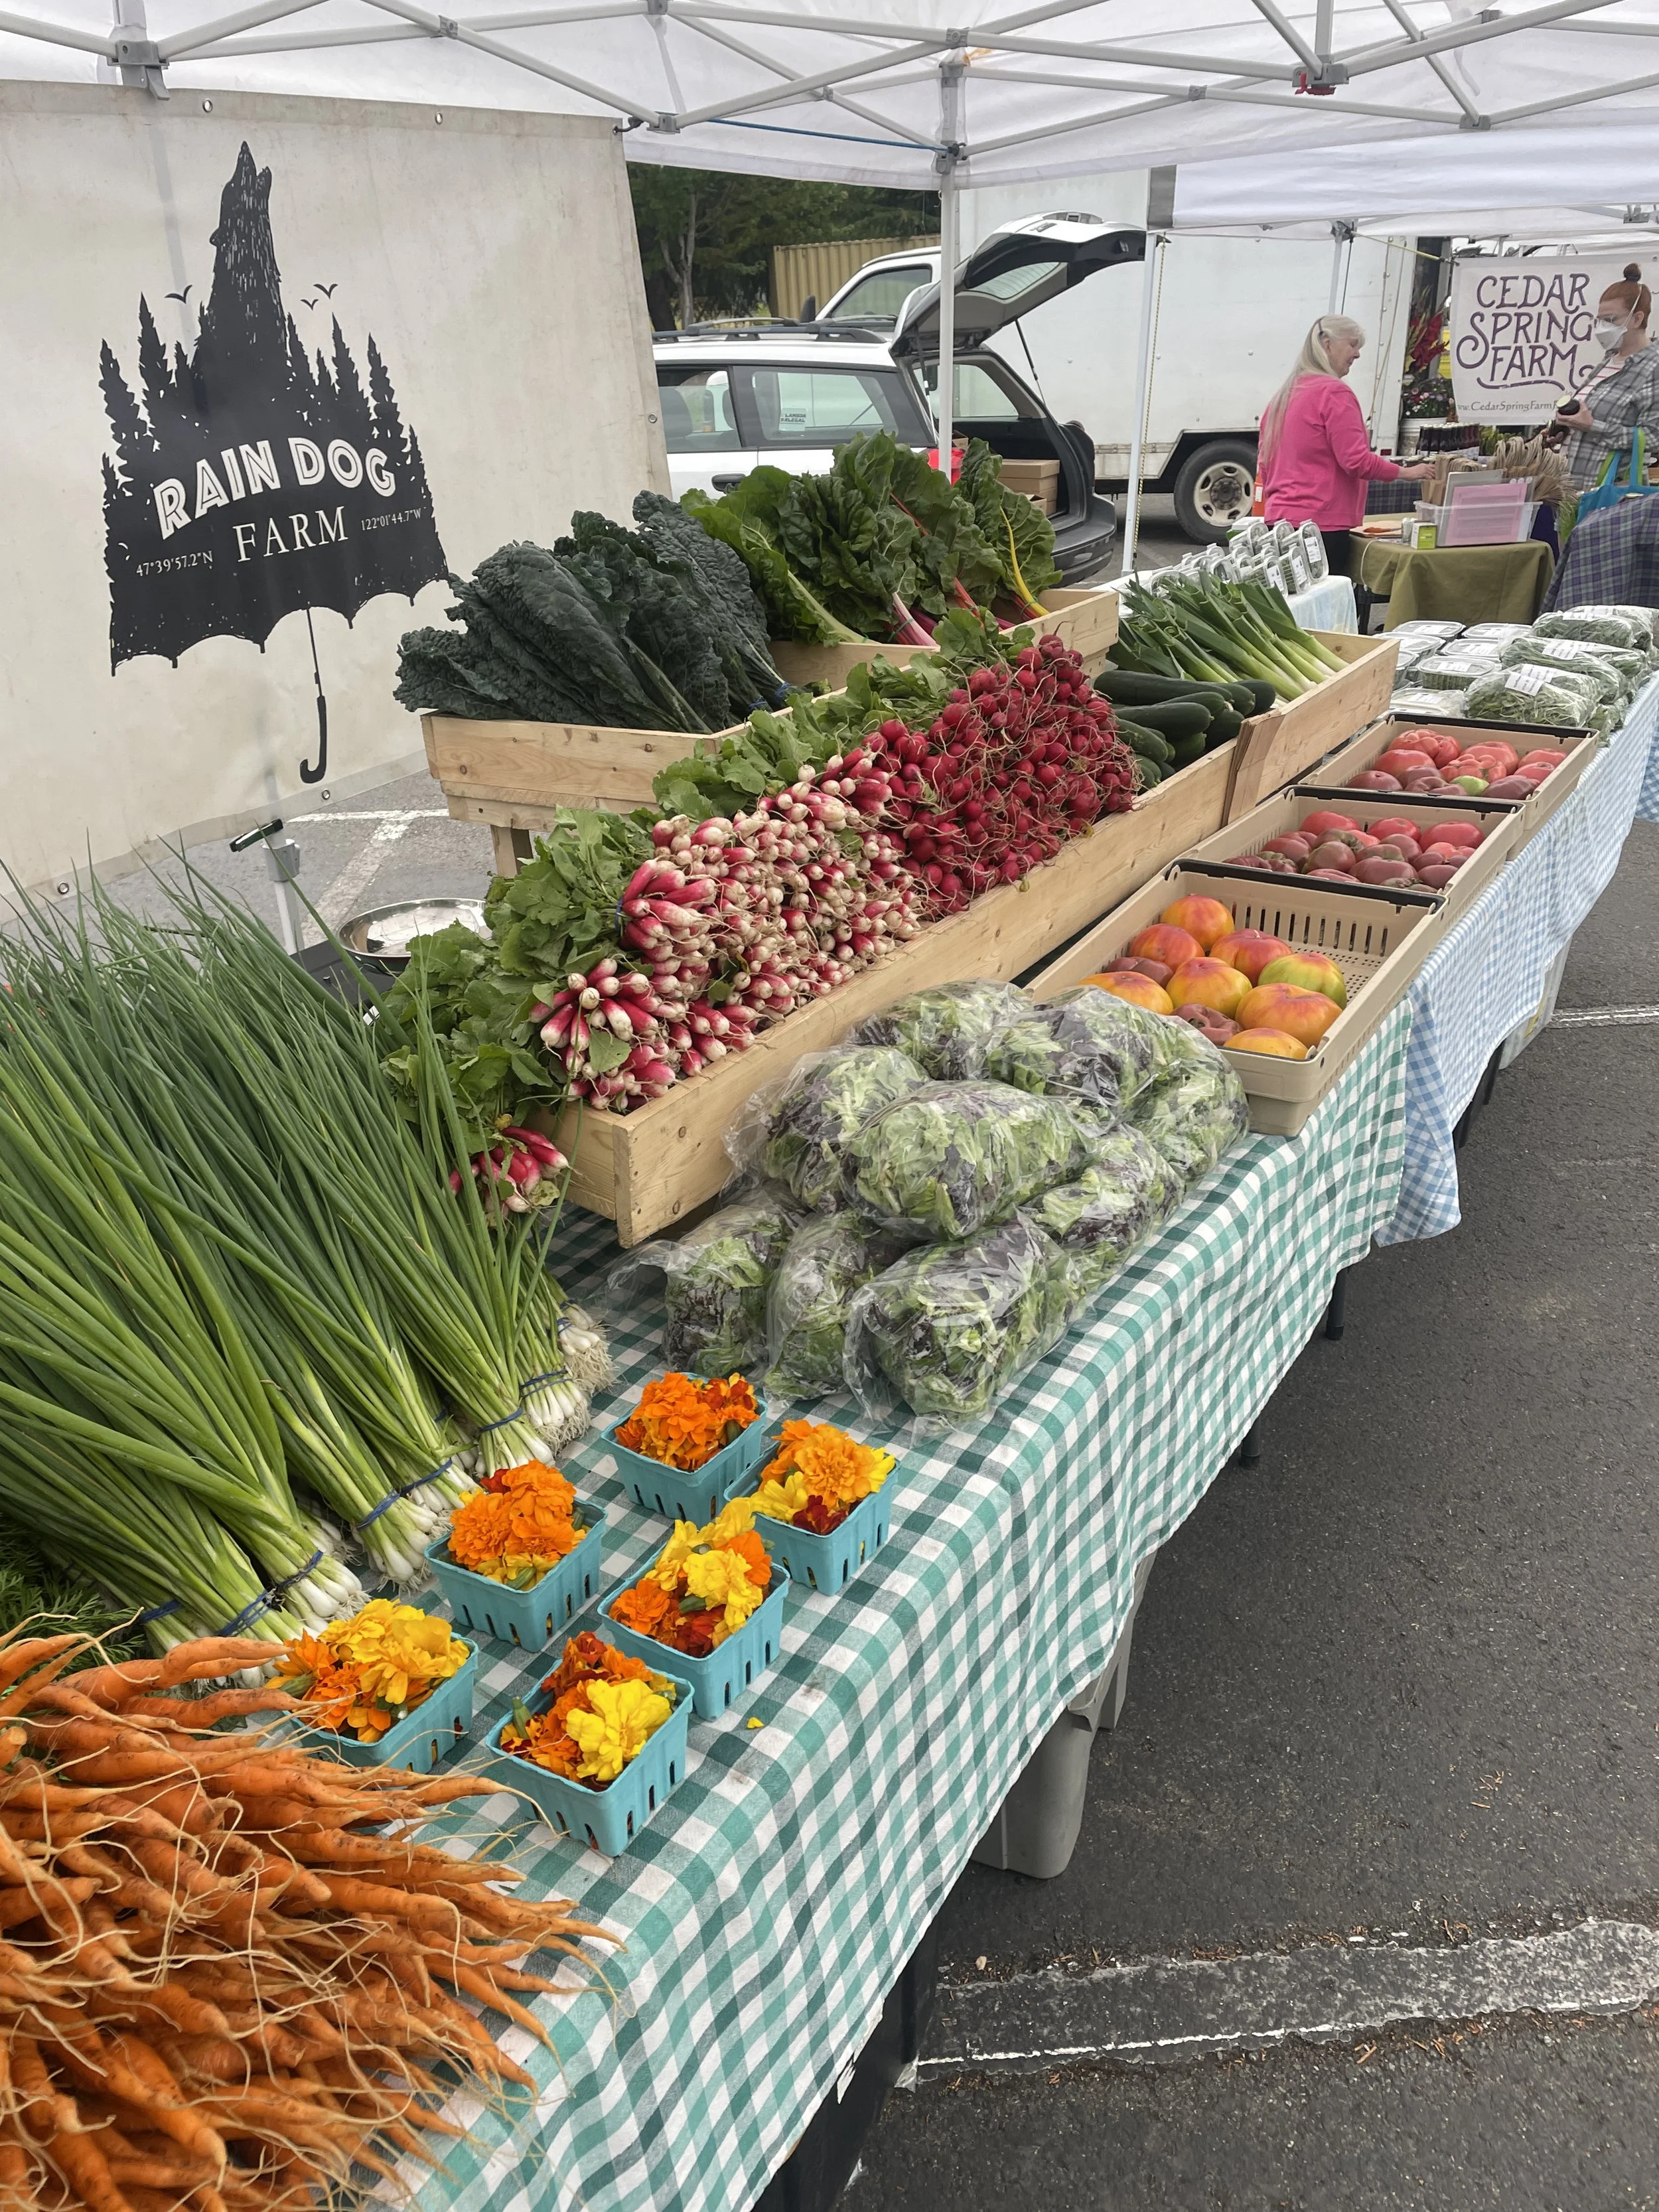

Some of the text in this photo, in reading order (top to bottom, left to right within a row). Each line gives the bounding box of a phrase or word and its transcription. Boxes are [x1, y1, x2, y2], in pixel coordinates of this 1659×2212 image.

[1477, 273, 1591, 314] CEDAR
[1456, 309, 1595, 369] SPRING
[1486, 341, 1594, 390] FARM
[152, 436, 397, 540] RAIN DOG
[232, 506, 348, 563] FARM
